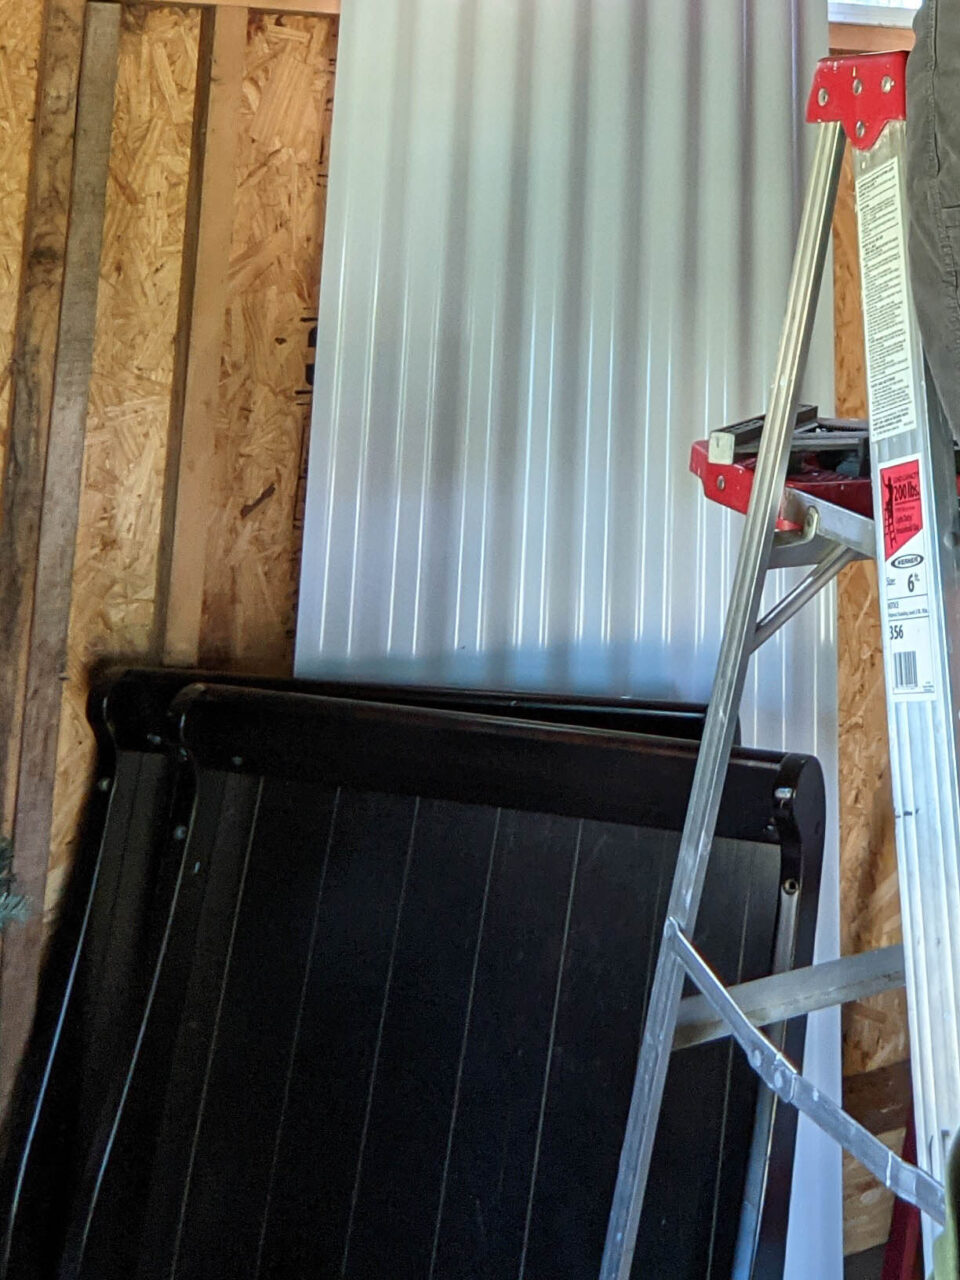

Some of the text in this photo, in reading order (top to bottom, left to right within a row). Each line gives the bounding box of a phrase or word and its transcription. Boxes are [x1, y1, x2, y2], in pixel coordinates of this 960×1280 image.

[894, 484, 907, 502] 200
[907, 573, 915, 593] 6
[889, 625, 904, 640] 356
